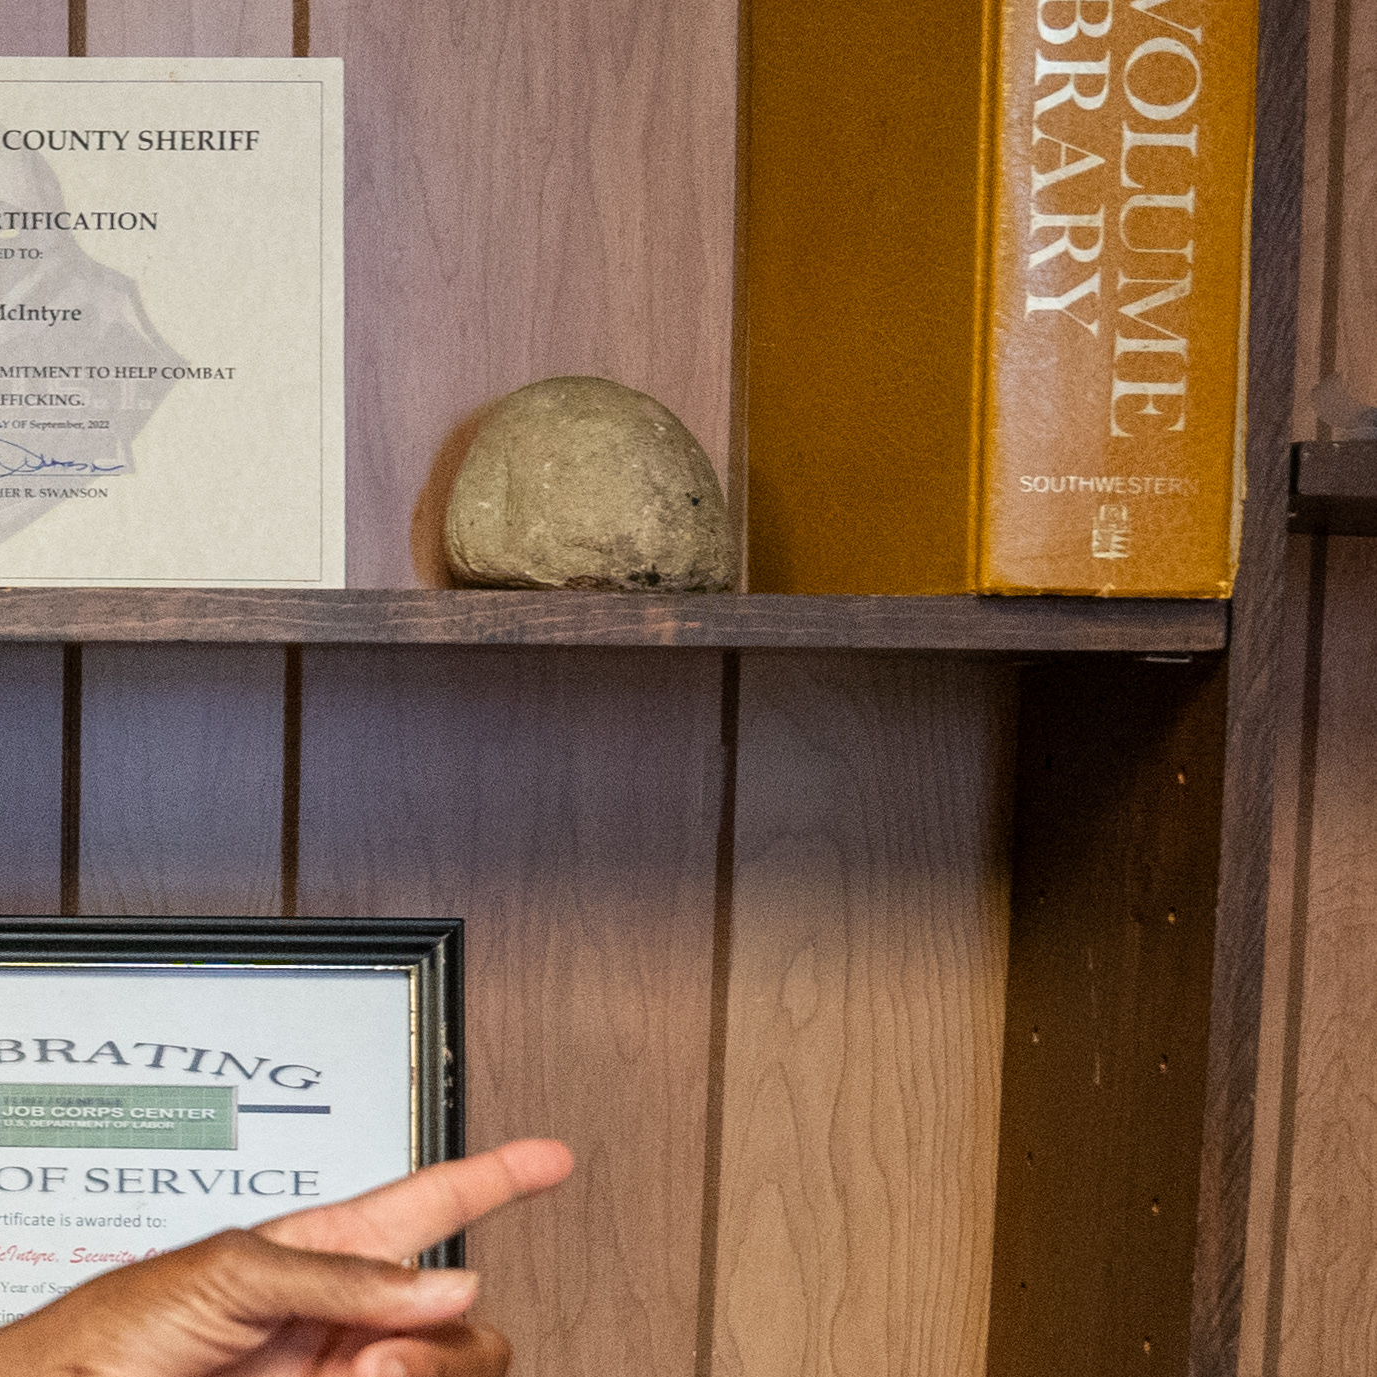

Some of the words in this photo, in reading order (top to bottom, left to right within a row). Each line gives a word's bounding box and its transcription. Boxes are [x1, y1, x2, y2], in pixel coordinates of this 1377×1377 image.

[2, 129, 130, 151] COUNTY
[137, 130, 259, 152] SHERIFF
[19, 248, 44, 260] TO:
[87, 366, 110, 380] TO
[114, 366, 157, 380] HELP
[161, 366, 236, 380] COMBAT
[12, 420, 28, 430] OF
[30, 420, 85, 432] September,
[87, 420, 109, 430] 2022
[39, 488, 108, 499] SWANSON
[1, 1105, 46, 1117] JOB
[50, 1107, 124, 1119] CORPS
[129, 1107, 216, 1120] CENTER
[29, 1119, 113, 1129] DEPARTMENT
[133, 1120, 175, 1129] LABOR
[83, 1166, 321, 1197] SERVICE
[60, 1212, 72, 1228] is
[76, 1212, 142, 1229] awarded
[146, 1213, 167, 1229] to:
[70, 1247, 136, 1265] Security
[0, 1281, 29, 1293] Year
[31, 1281, 44, 1293] of
